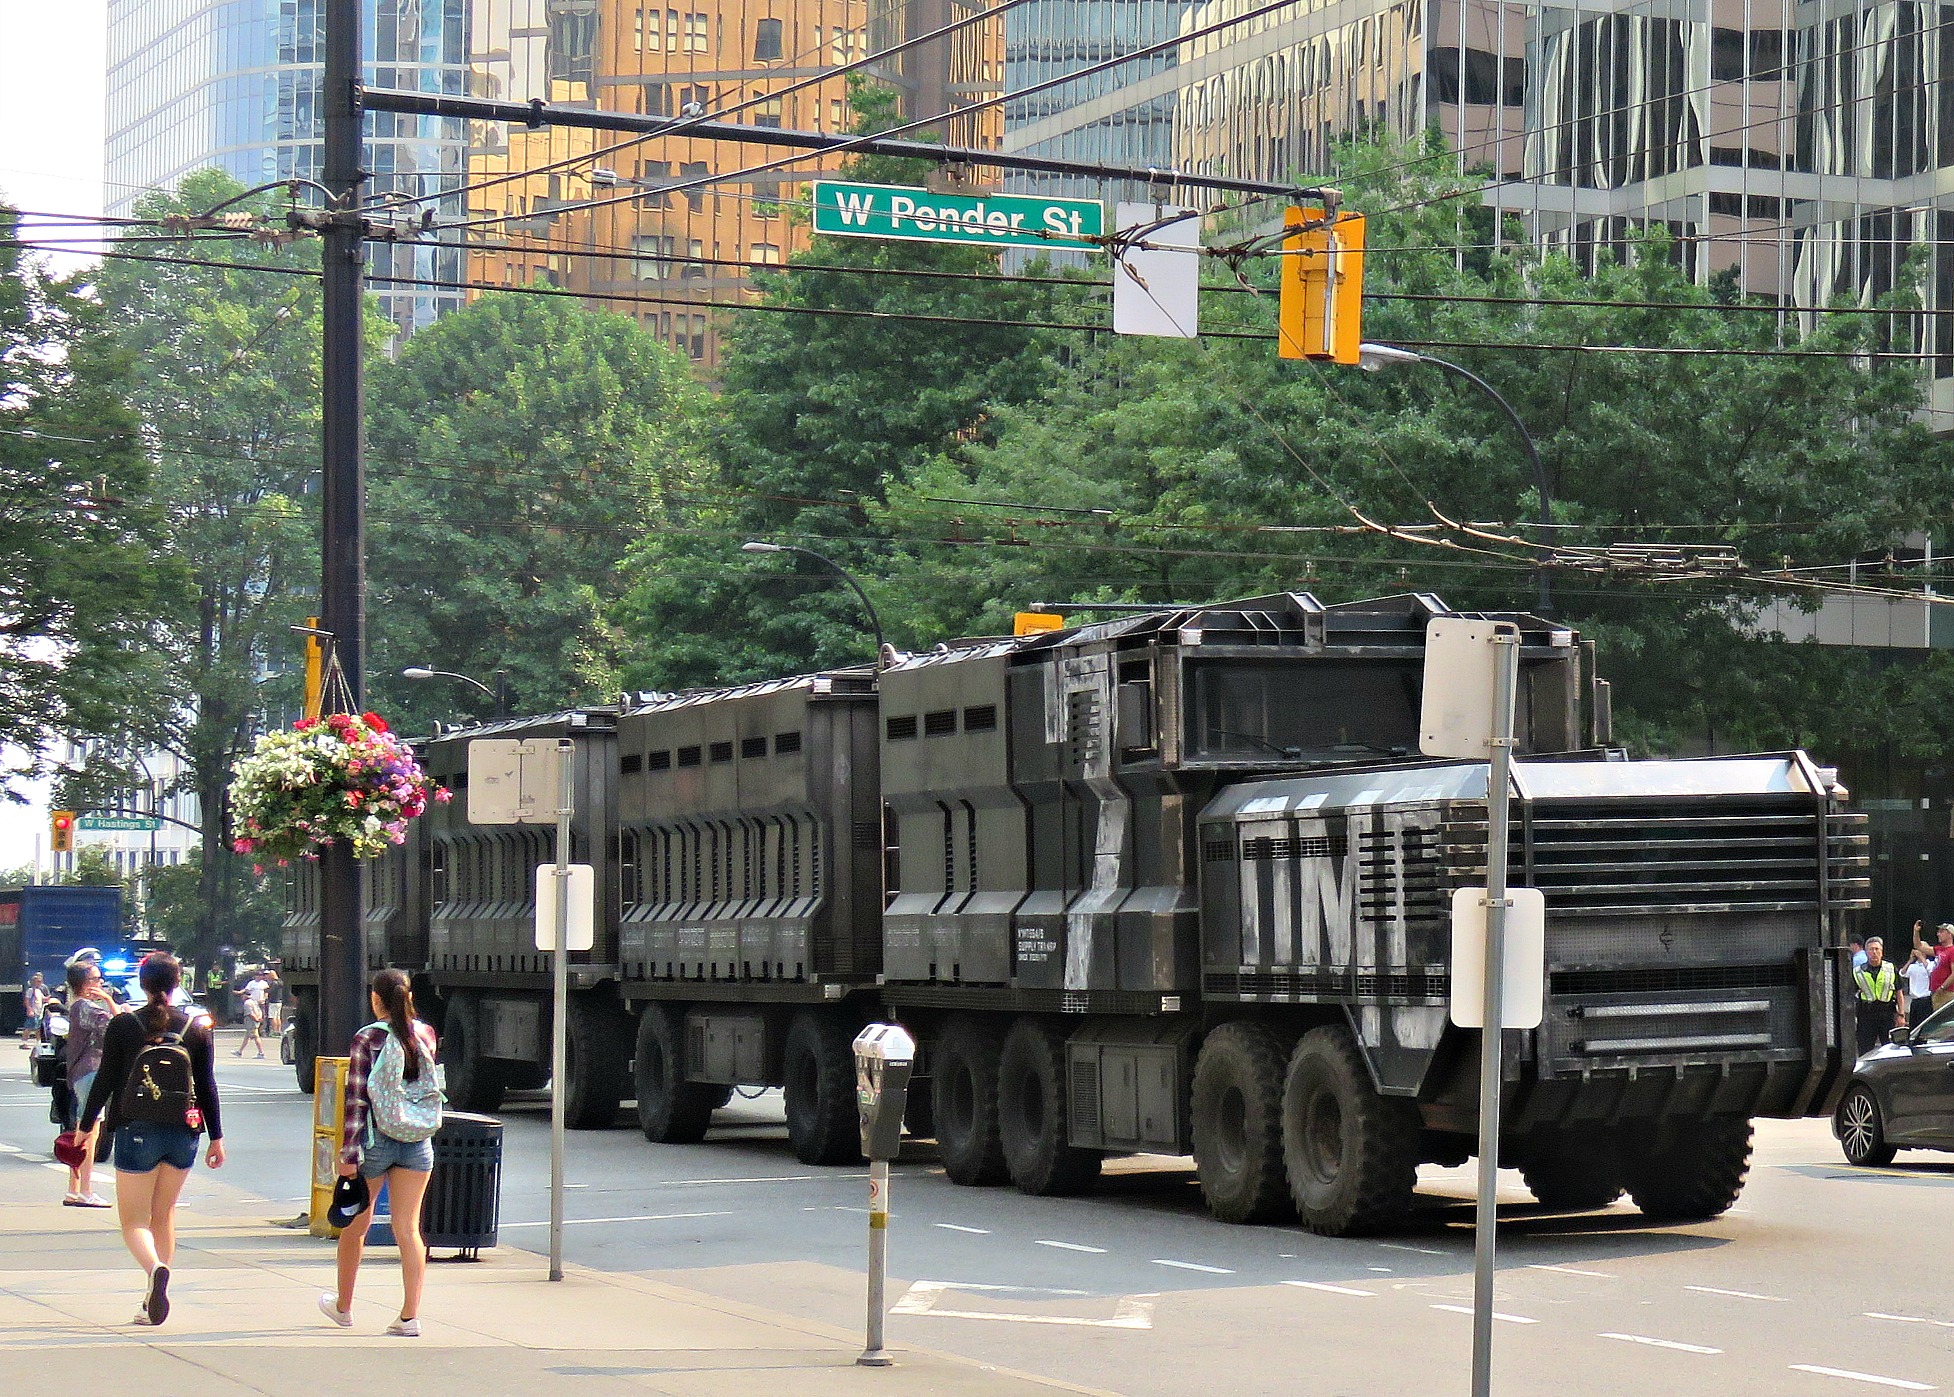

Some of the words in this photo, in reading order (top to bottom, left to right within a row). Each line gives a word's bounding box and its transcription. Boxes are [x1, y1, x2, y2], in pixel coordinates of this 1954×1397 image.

[835, 191, 874, 226] W
[891, 196, 1025, 237] Pender
[1043, 206, 1083, 237] St
[84, 819, 94, 828] W
[98, 819, 141, 830] Hastings
[145, 819, 156, 829] St
